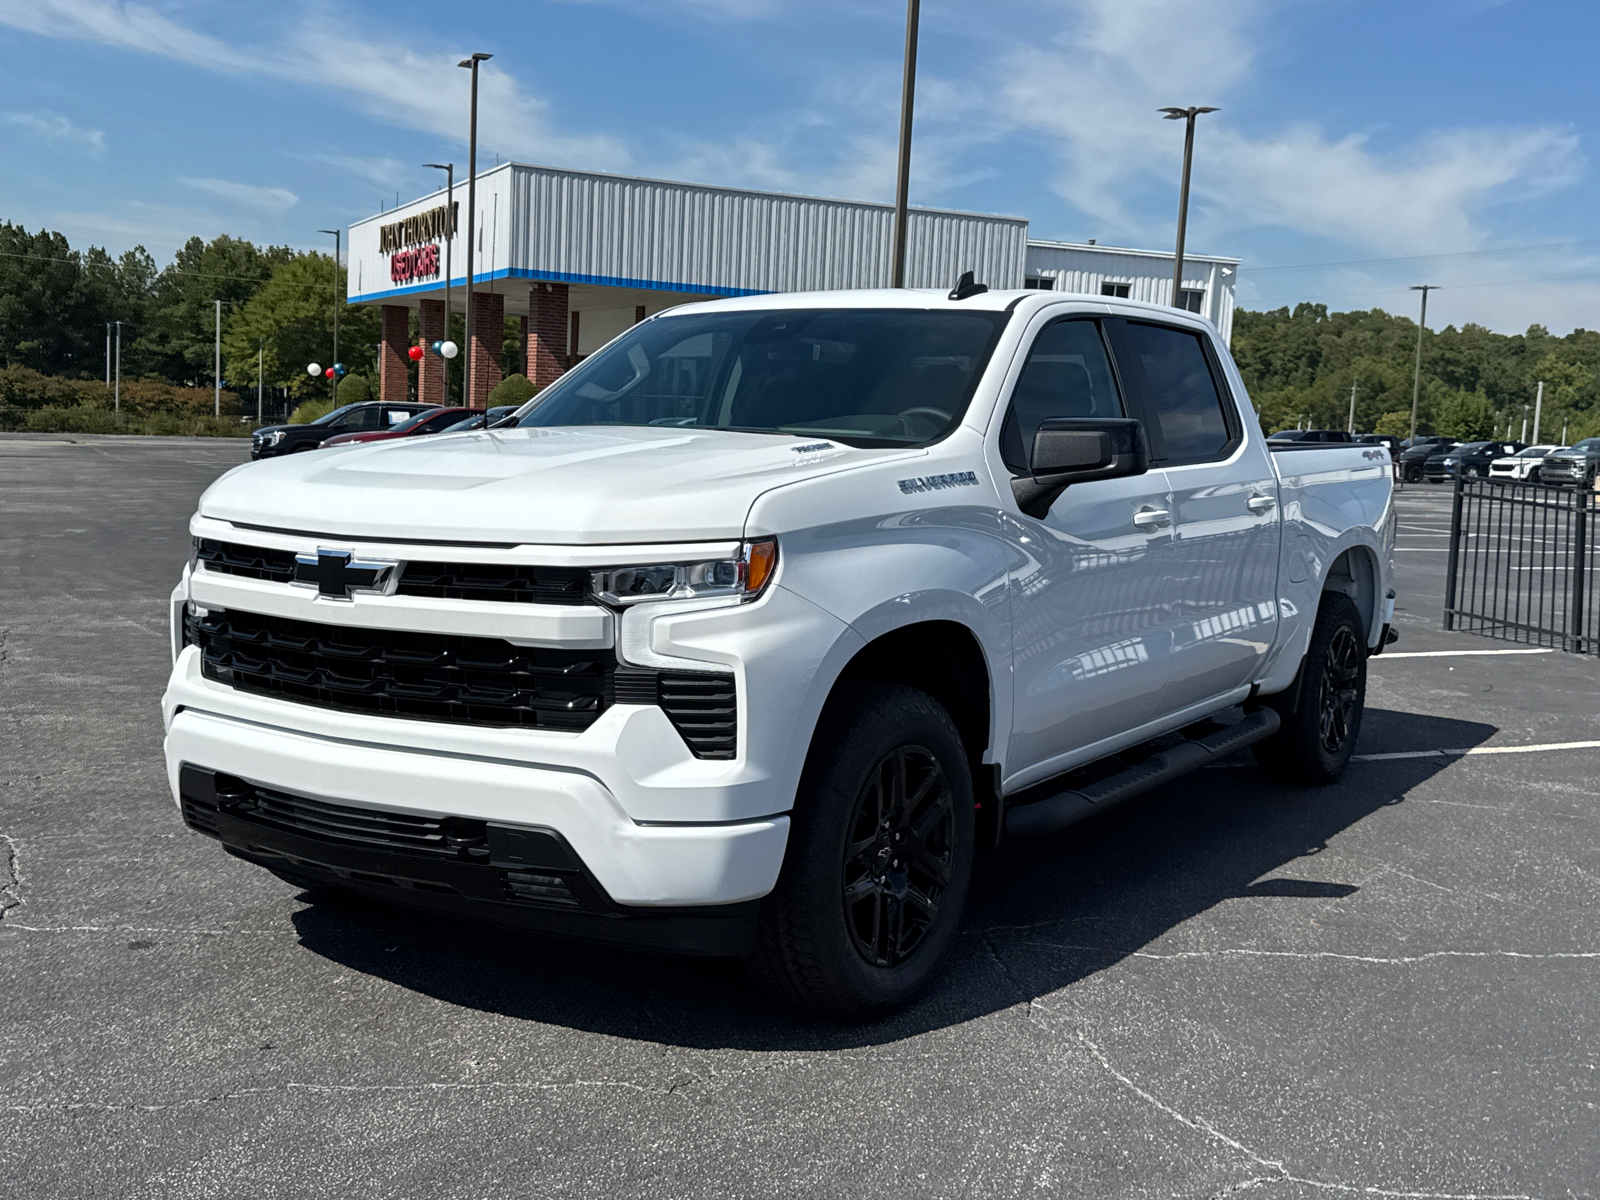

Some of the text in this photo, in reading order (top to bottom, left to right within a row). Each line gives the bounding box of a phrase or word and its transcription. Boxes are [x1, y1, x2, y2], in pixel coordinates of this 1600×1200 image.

[379, 221, 402, 254] JOHN
[391, 244, 438, 282] USED CARS
[897, 471, 977, 491] SILVERADO
